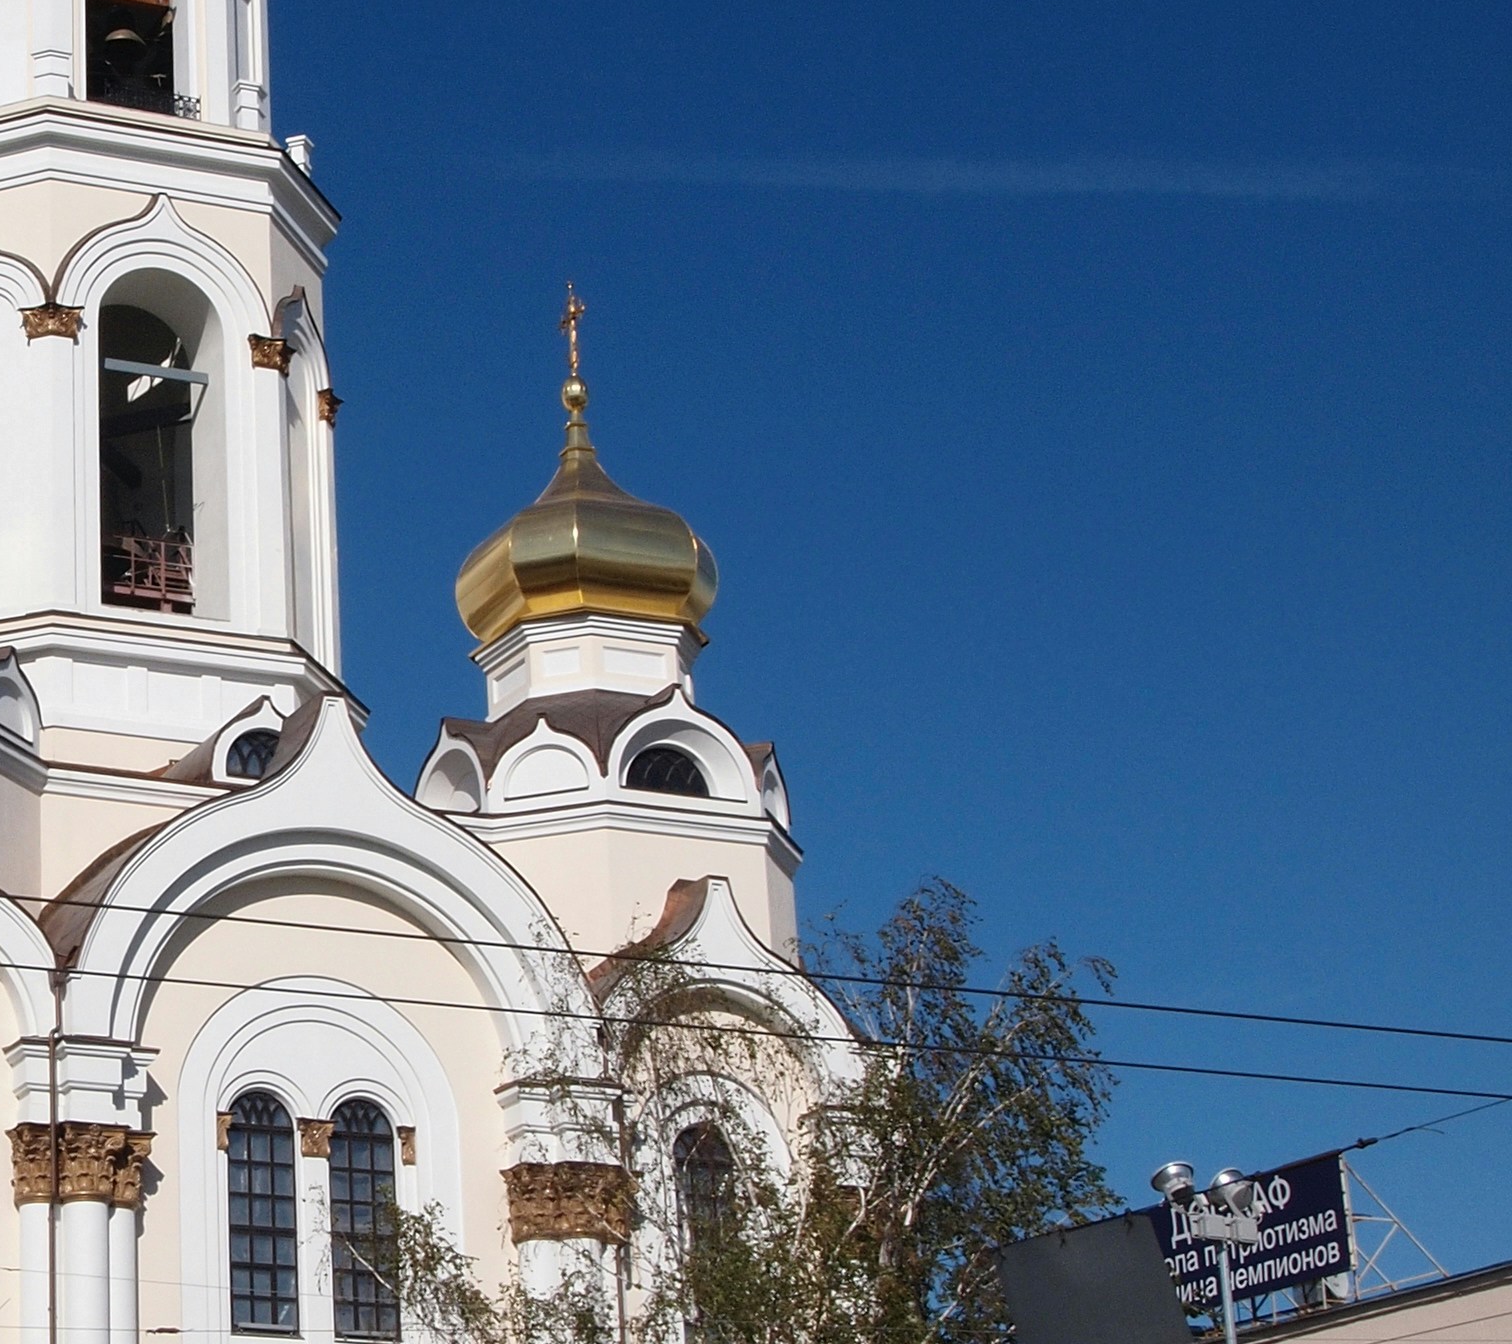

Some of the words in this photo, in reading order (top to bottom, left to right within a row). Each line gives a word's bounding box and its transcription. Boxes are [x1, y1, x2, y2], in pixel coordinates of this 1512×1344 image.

[1164, 1250, 1199, 1275] ола
[1203, 1208, 1338, 1267] птриотизма
[1170, 1175, 1292, 1250] ДАФ
